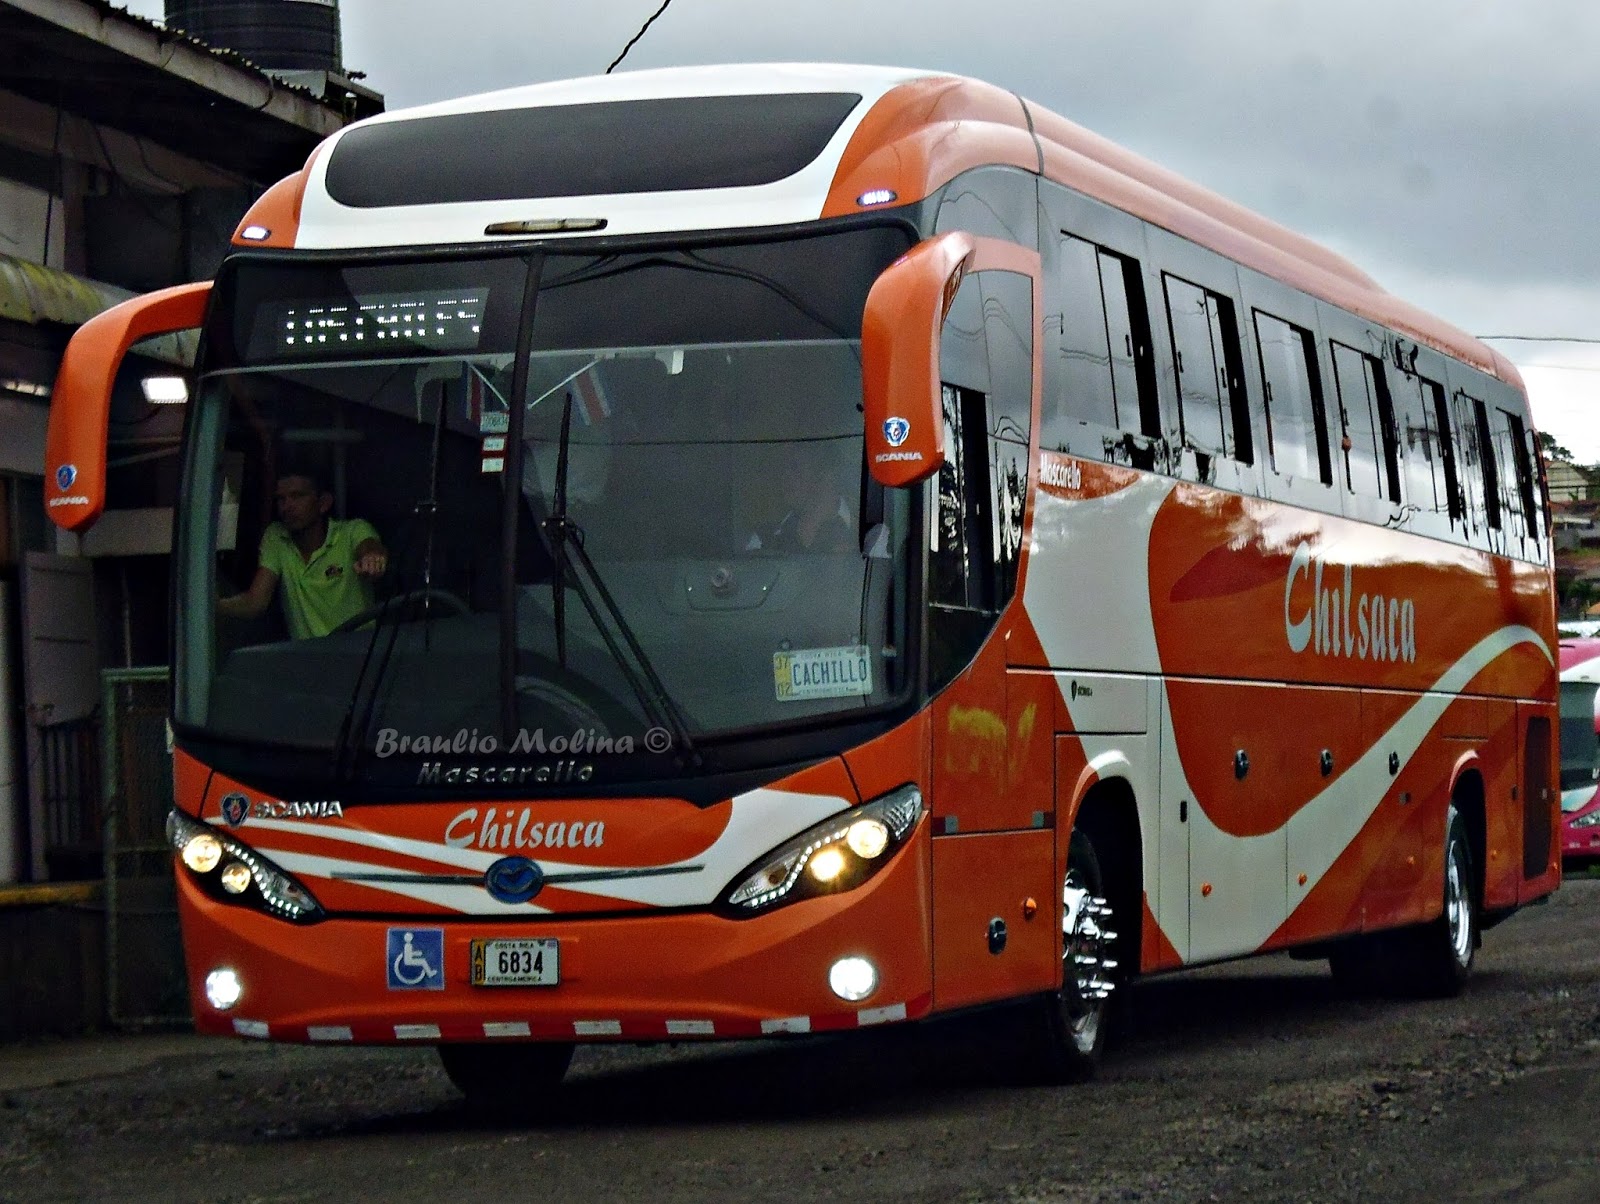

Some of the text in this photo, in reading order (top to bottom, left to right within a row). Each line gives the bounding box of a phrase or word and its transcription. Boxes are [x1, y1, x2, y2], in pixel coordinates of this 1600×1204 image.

[875, 451, 924, 463] SCANIA
[1284, 539, 1417, 664] Chilsaca
[793, 658, 867, 686] CACHILLO
[254, 800, 344, 819] SCANIA
[444, 807, 605, 849] Chilsaca
[498, 951, 543, 974] 6834
